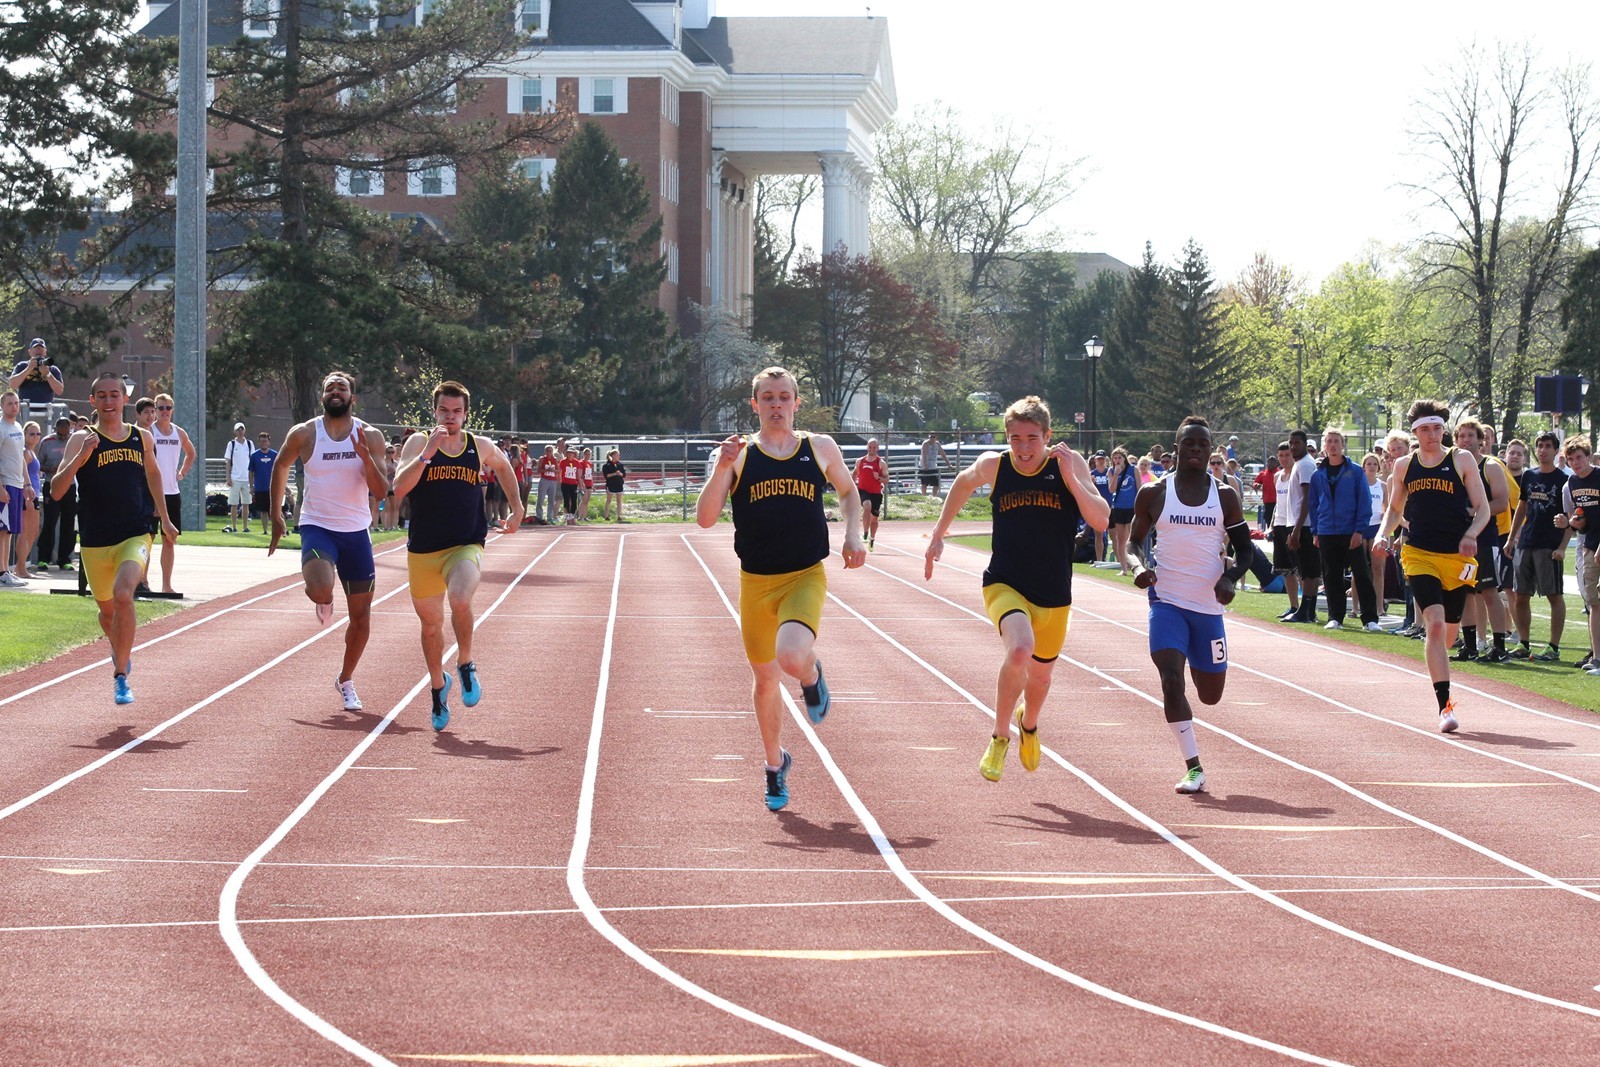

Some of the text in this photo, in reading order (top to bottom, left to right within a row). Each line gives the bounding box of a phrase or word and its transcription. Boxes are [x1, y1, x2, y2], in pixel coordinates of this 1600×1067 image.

[98, 448, 144, 468] AUGUSTANA
[322, 451, 357, 461] NORTH PARK
[427, 465, 477, 486] AUGUSTANA
[750, 479, 815, 504] AUGUSTANA
[999, 490, 1062, 513] AUGUSTANA
[1169, 514, 1217, 527] MILLIKIN
[1215, 641, 1225, 661] 3
